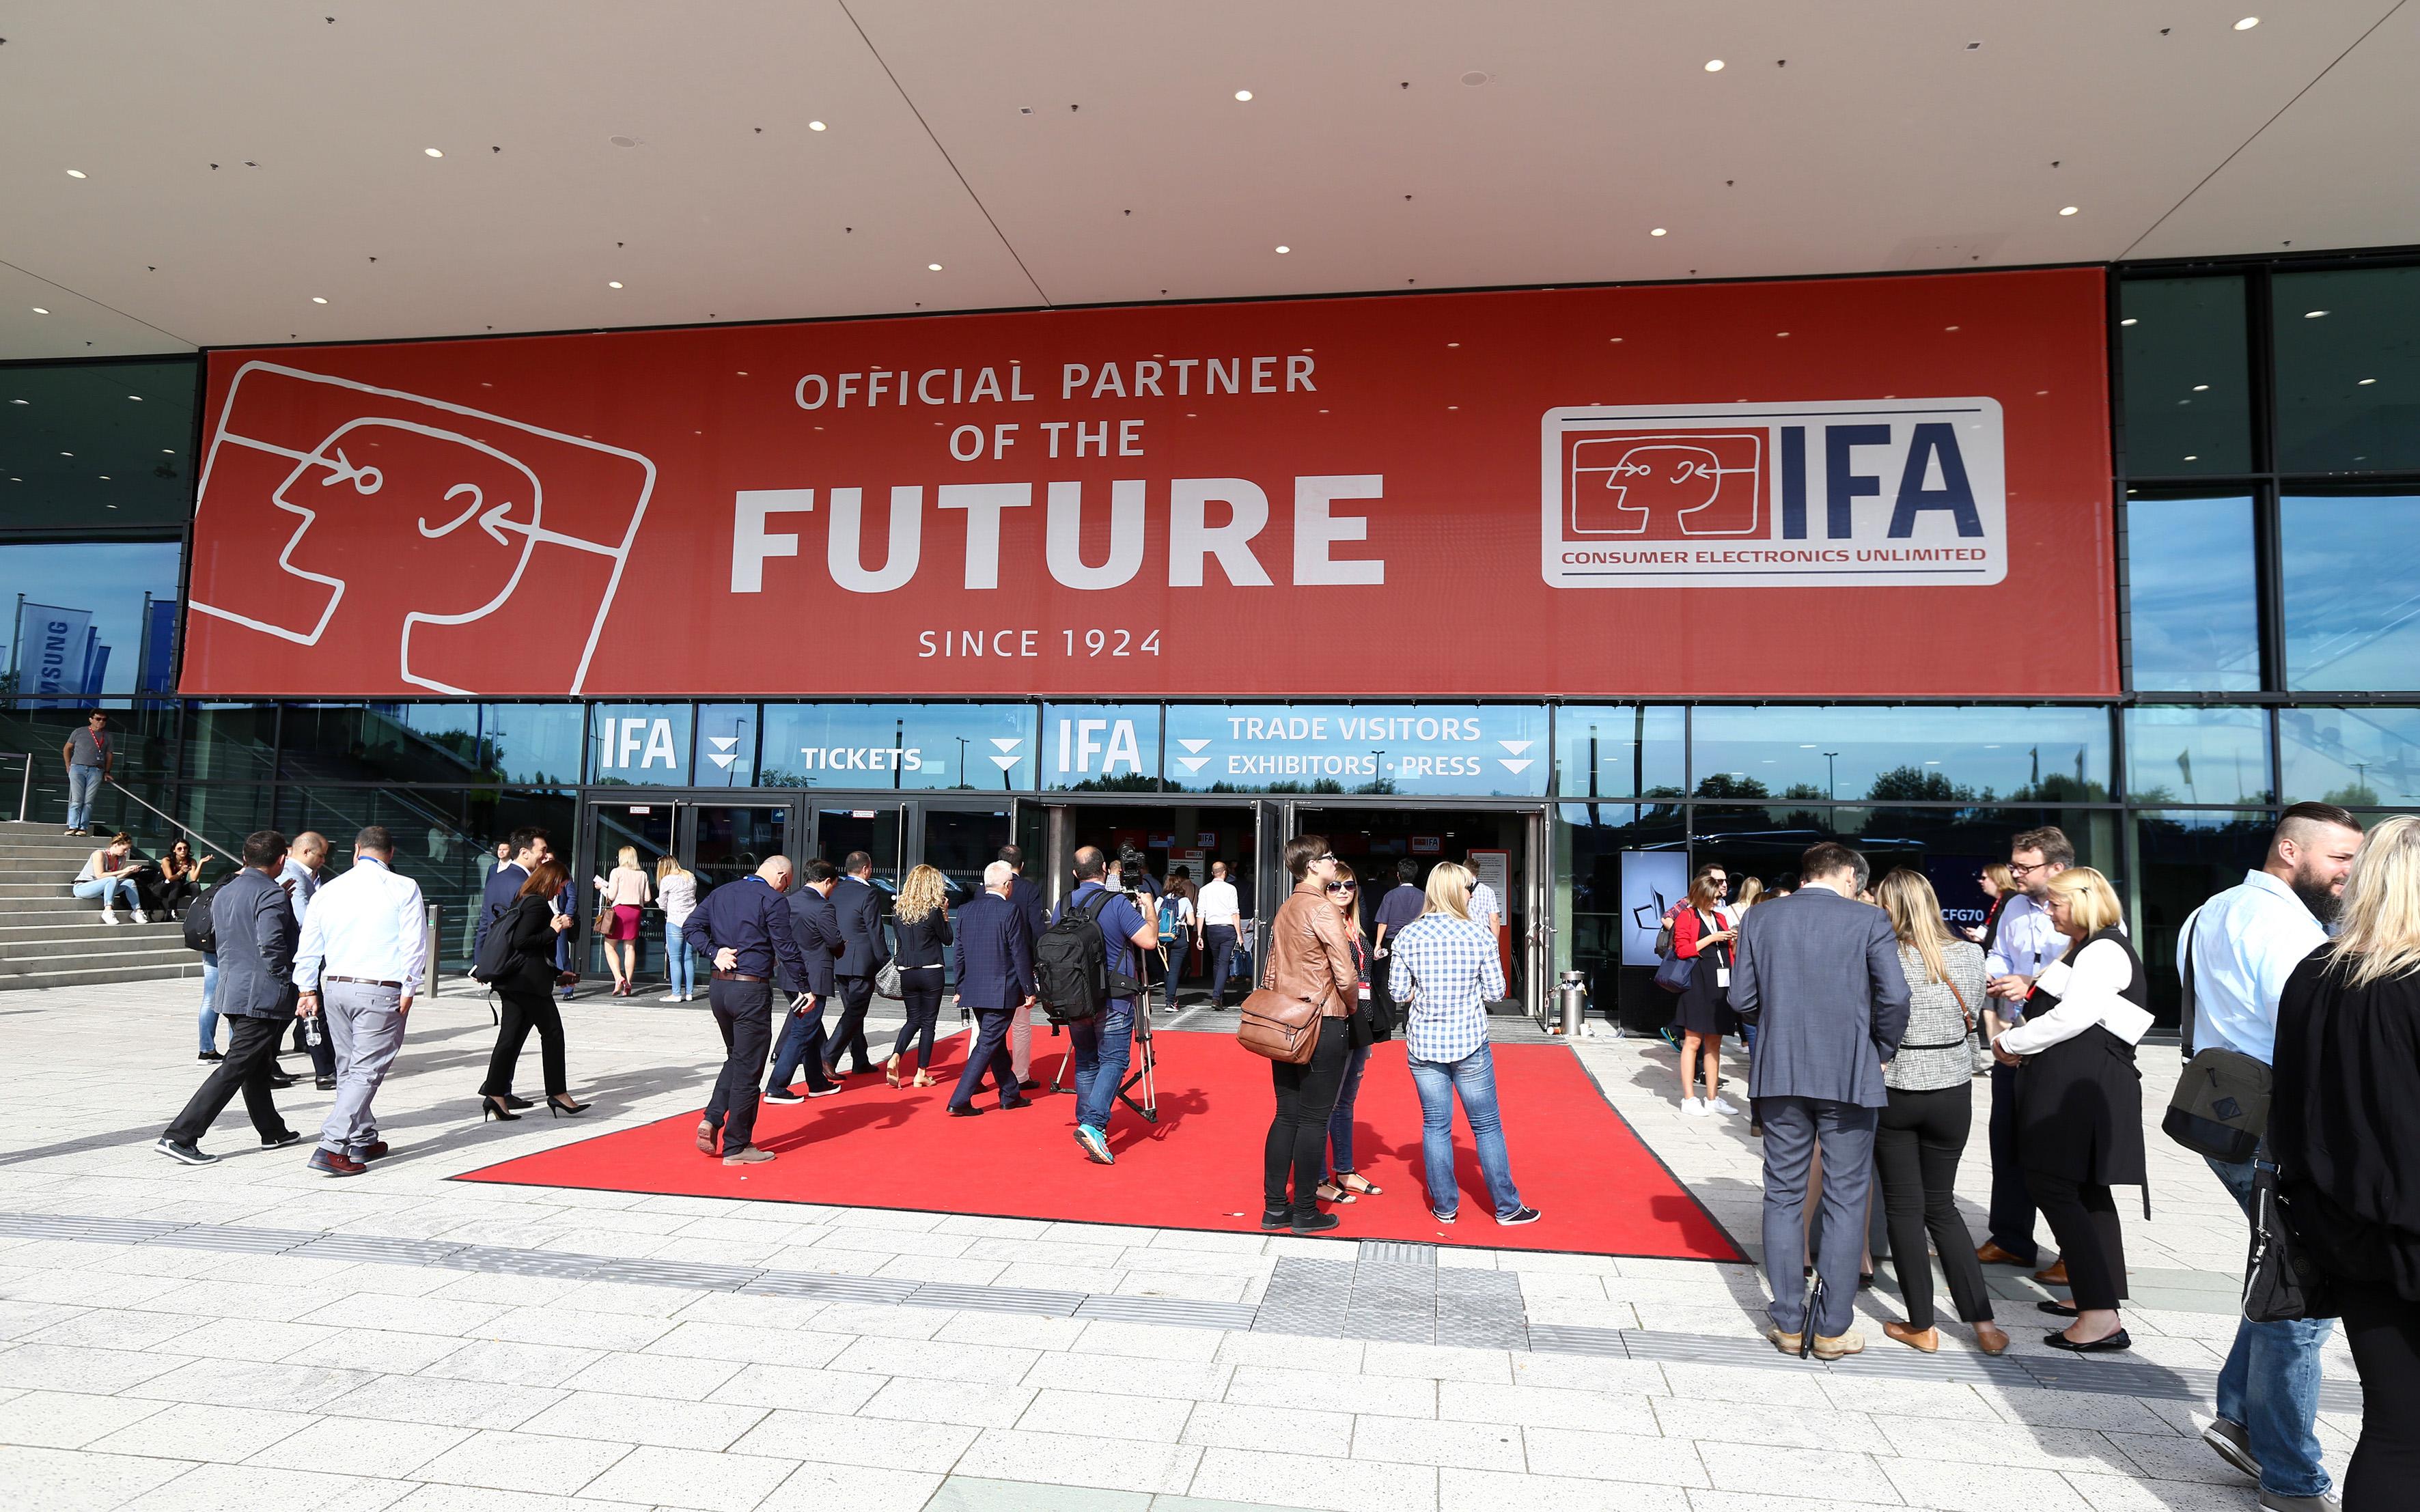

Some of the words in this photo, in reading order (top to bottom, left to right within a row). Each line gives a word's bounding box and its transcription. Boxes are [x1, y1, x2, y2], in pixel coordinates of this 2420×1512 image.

[794, 365, 1035, 410] OFFICIAL
[1061, 354, 1318, 400] PARTNER
[949, 423, 1020, 462] OF
[1040, 419, 1145, 459] THE
[1779, 421, 1985, 540] IFA
[729, 473, 1385, 594] FUTURE
[1561, 550, 1689, 565] CONSUMER
[1695, 548, 1850, 564] ELECTRONICS
[1856, 548, 1986, 563] UNLIMITED
[917, 629, 1039, 658] SINCE
[1062, 628, 1160, 658] 1924
[40, 621, 68, 709] MSUNG
[602, 717, 677, 770] IFA
[1058, 718, 1143, 774] IFA
[1227, 716, 1328, 740] TRADE
[1337, 716, 1482, 742] VISITORS
[800, 747, 922, 771] TICKETS
[1227, 755, 1377, 776] EXHIBITORS
[1402, 755, 1482, 776] PRESS
[1426, 837, 1438, 846] IFA
[1941, 909, 1984, 921] CFG70
